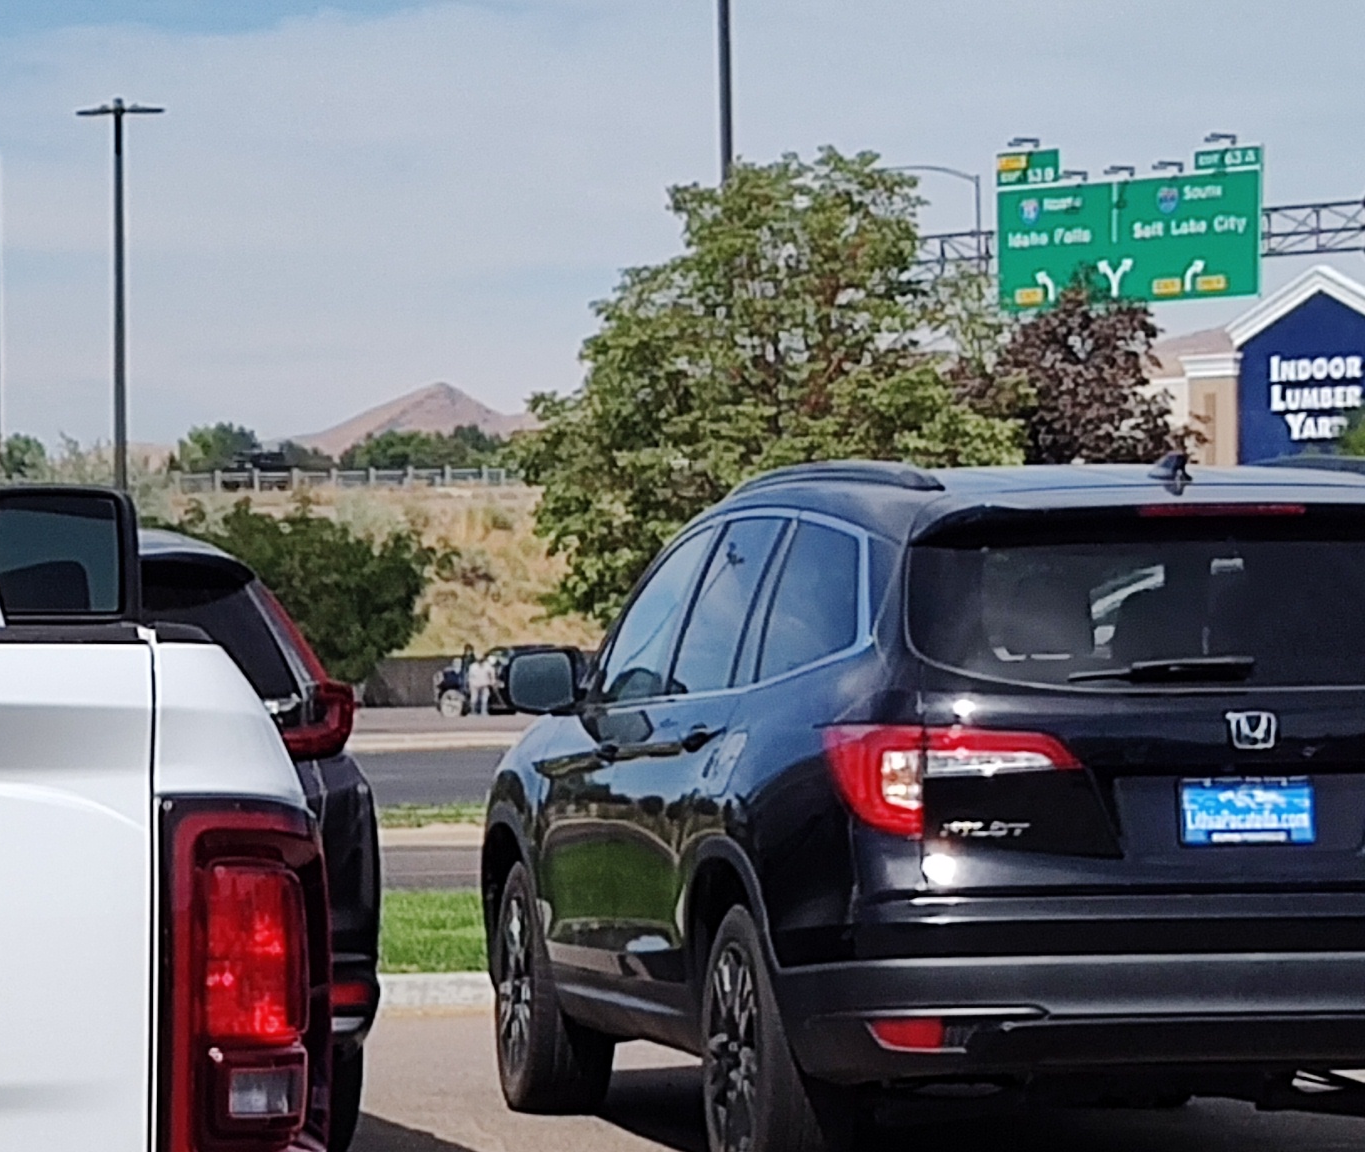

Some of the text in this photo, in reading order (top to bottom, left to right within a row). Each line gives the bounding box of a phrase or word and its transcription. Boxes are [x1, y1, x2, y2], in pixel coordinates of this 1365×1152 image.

[1213, 214, 1247, 233] City
[1008, 227, 1092, 249] Idaho Falls
[1270, 354, 1363, 382] INDOOR
[1271, 384, 1363, 412] LUMBER
